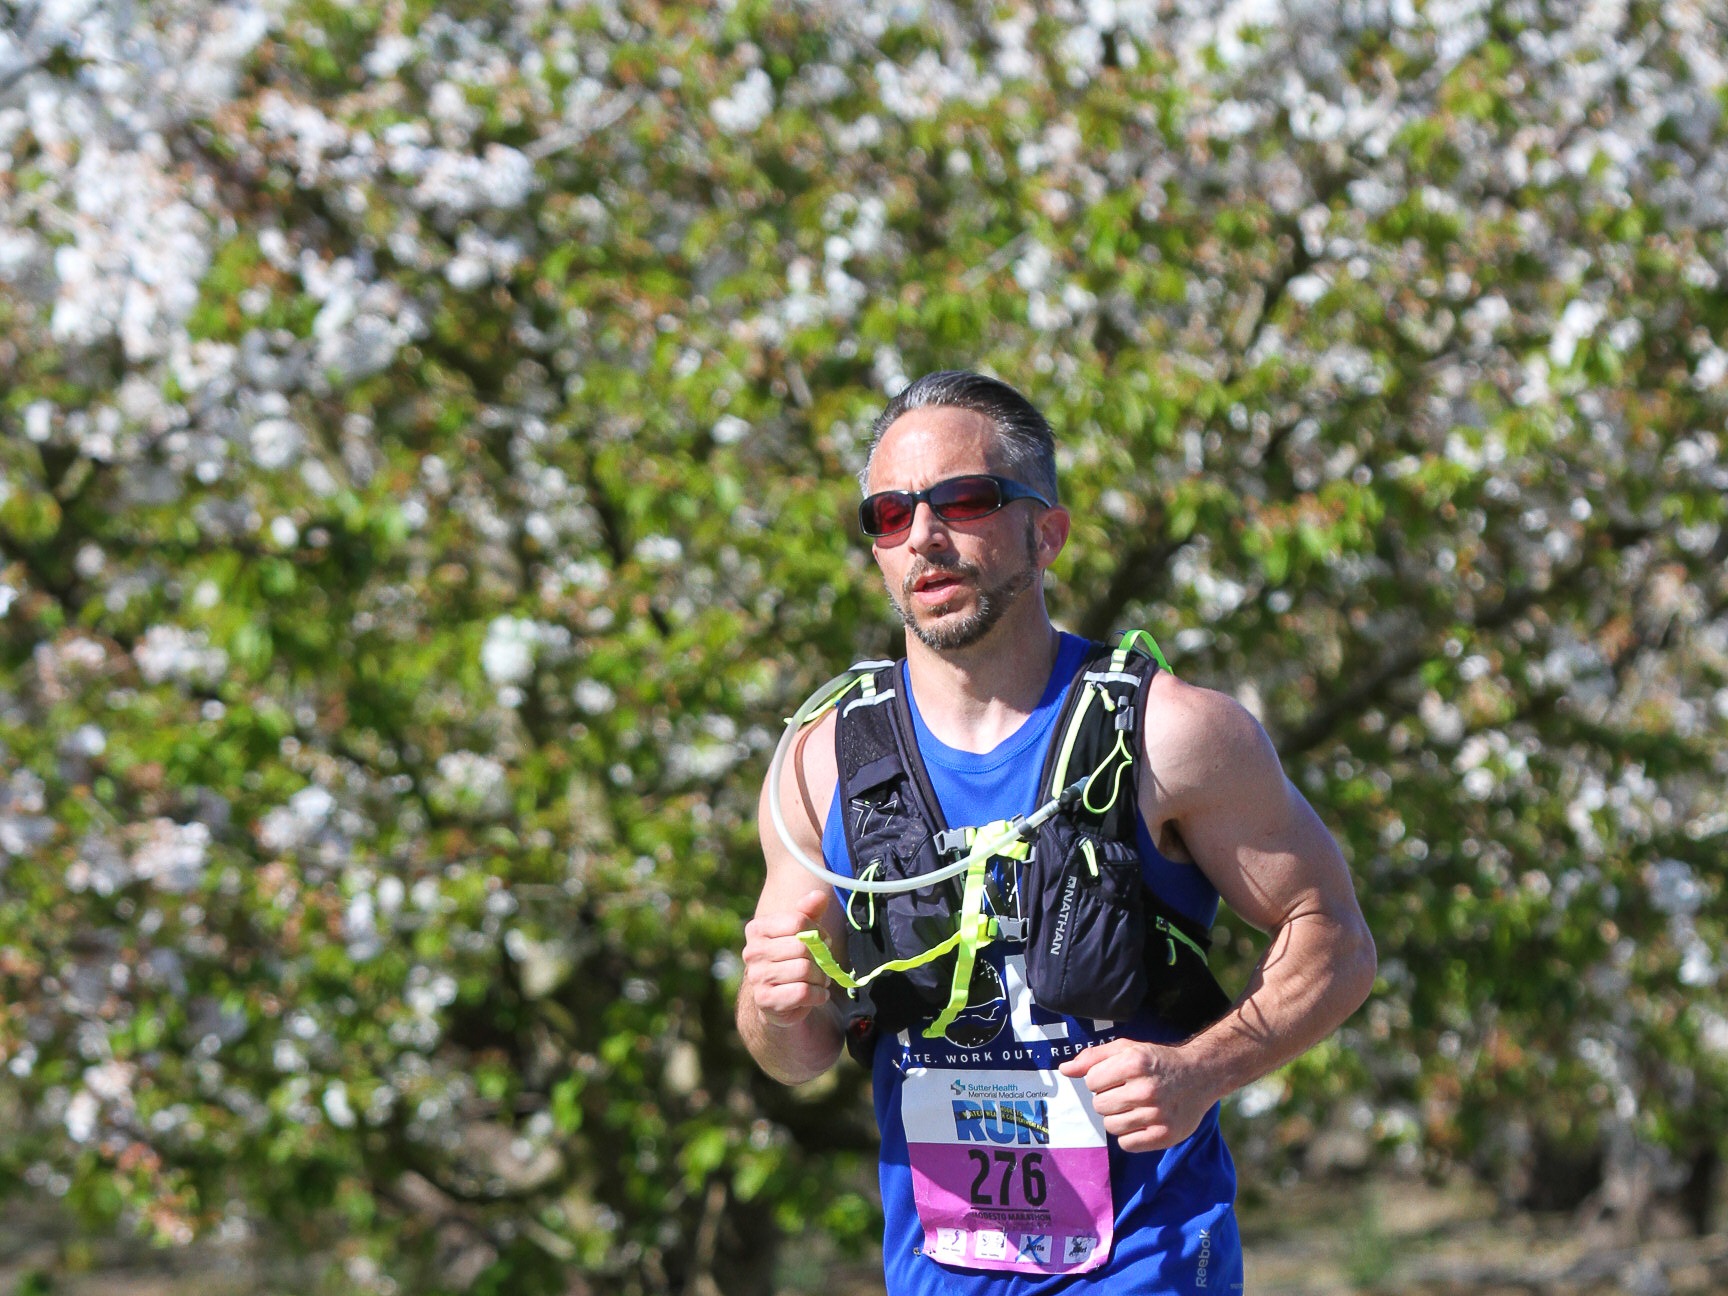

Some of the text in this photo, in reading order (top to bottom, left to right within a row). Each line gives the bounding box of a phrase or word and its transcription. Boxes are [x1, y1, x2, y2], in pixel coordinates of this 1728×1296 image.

[1050, 889, 1074, 956] NATHAN
[946, 1052, 993, 1064] WORK
[1003, 1049, 1040, 1062] OUT.
[968, 1083, 1018, 1092] Sutter Health
[968, 1091, 997, 1099] Memorial
[999, 1091, 1024, 1099] Medical
[952, 1100, 1050, 1144] RUN
[968, 1149, 1047, 1207] 276
[1195, 1228, 1211, 1288] Reebok
